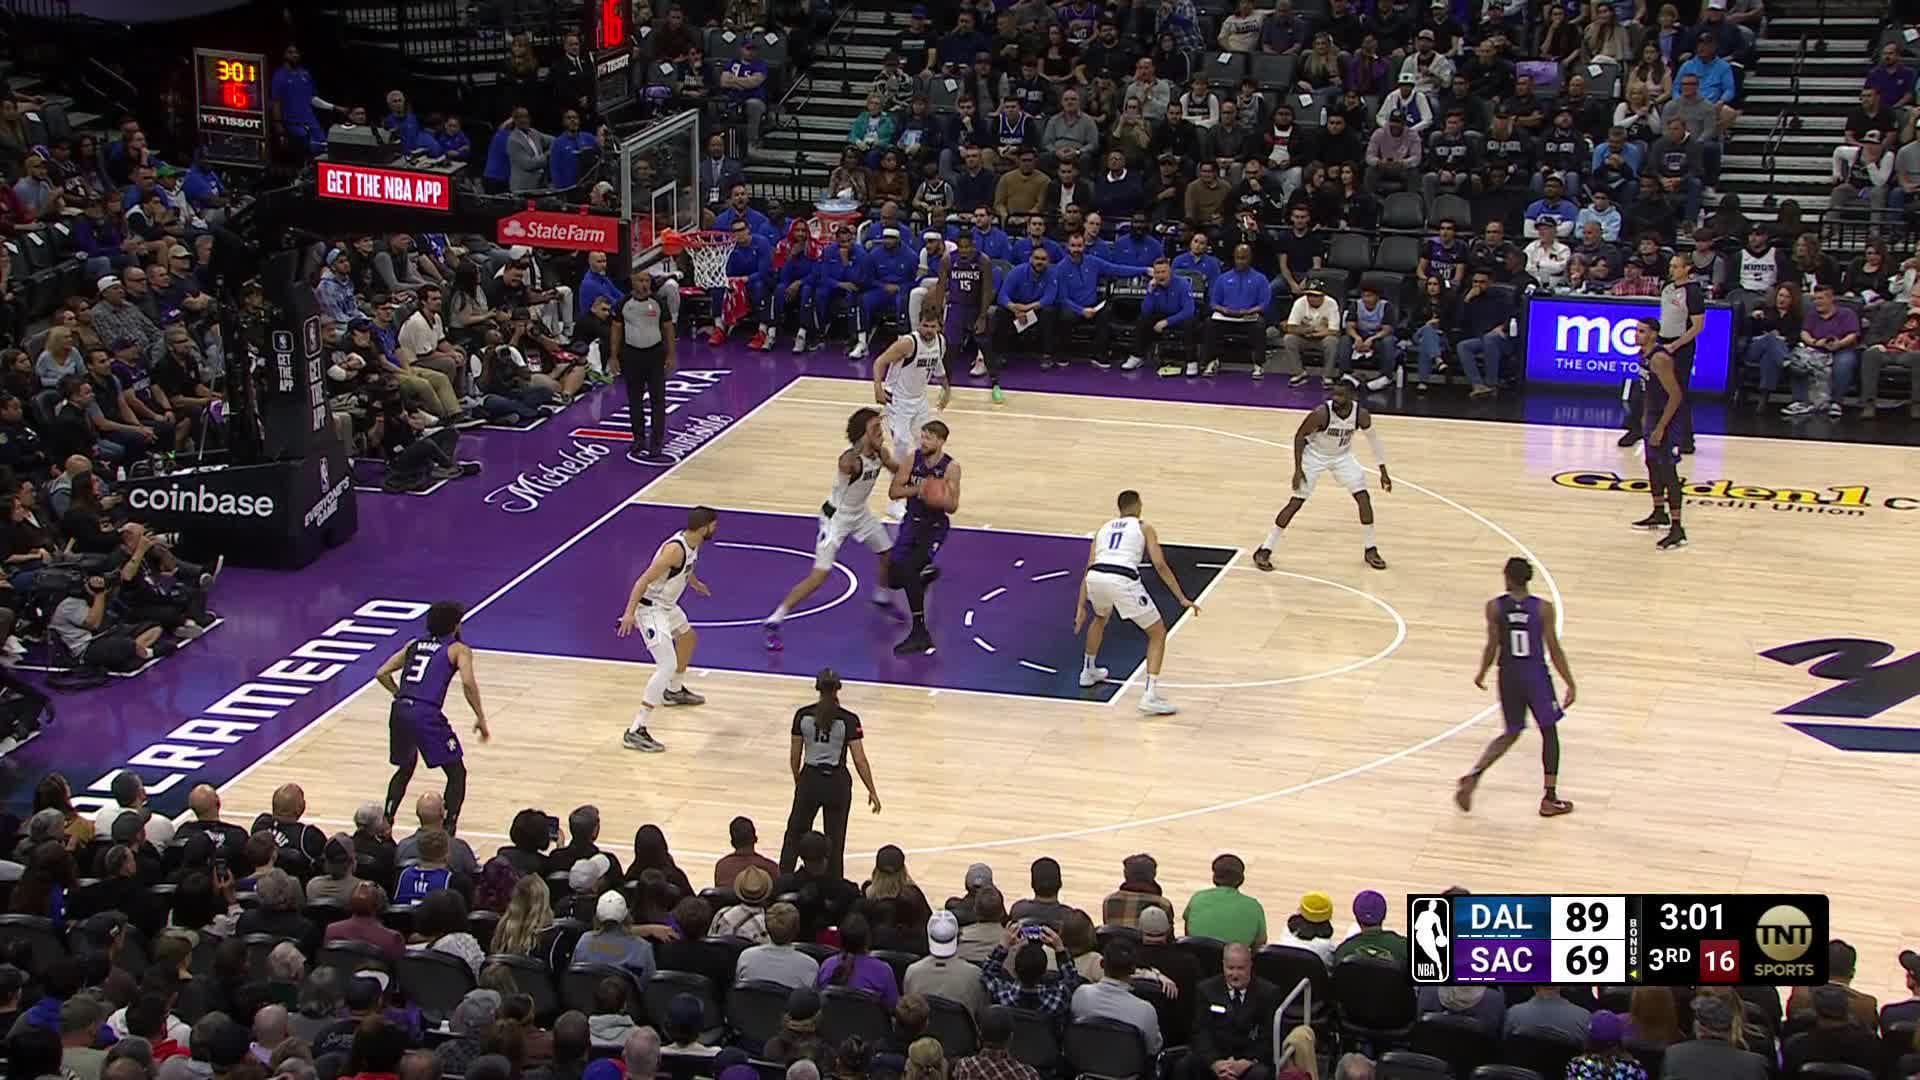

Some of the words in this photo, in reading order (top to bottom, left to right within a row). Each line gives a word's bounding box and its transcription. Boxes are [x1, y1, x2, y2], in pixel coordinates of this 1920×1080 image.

[217, 60, 255, 82] 3:01
[327, 169, 352, 195] GET
[355, 172, 381, 198] THE
[384, 175, 413, 202] NBA
[415, 179, 441, 204] APP
[951, 270, 980, 280] KINGS
[960, 280, 971, 291] 15
[277, 353, 291, 366] GET
[1555, 357, 1581, 370] THE
[1586, 359, 1616, 372] ONE
[484, 440, 610, 513] Michelob
[129, 483, 274, 517] coinbase
[1686, 498, 1757, 510] redit
[1772, 502, 1866, 518] Union
[1510, 630, 1529, 656] 0
[406, 655, 431, 682] 3
